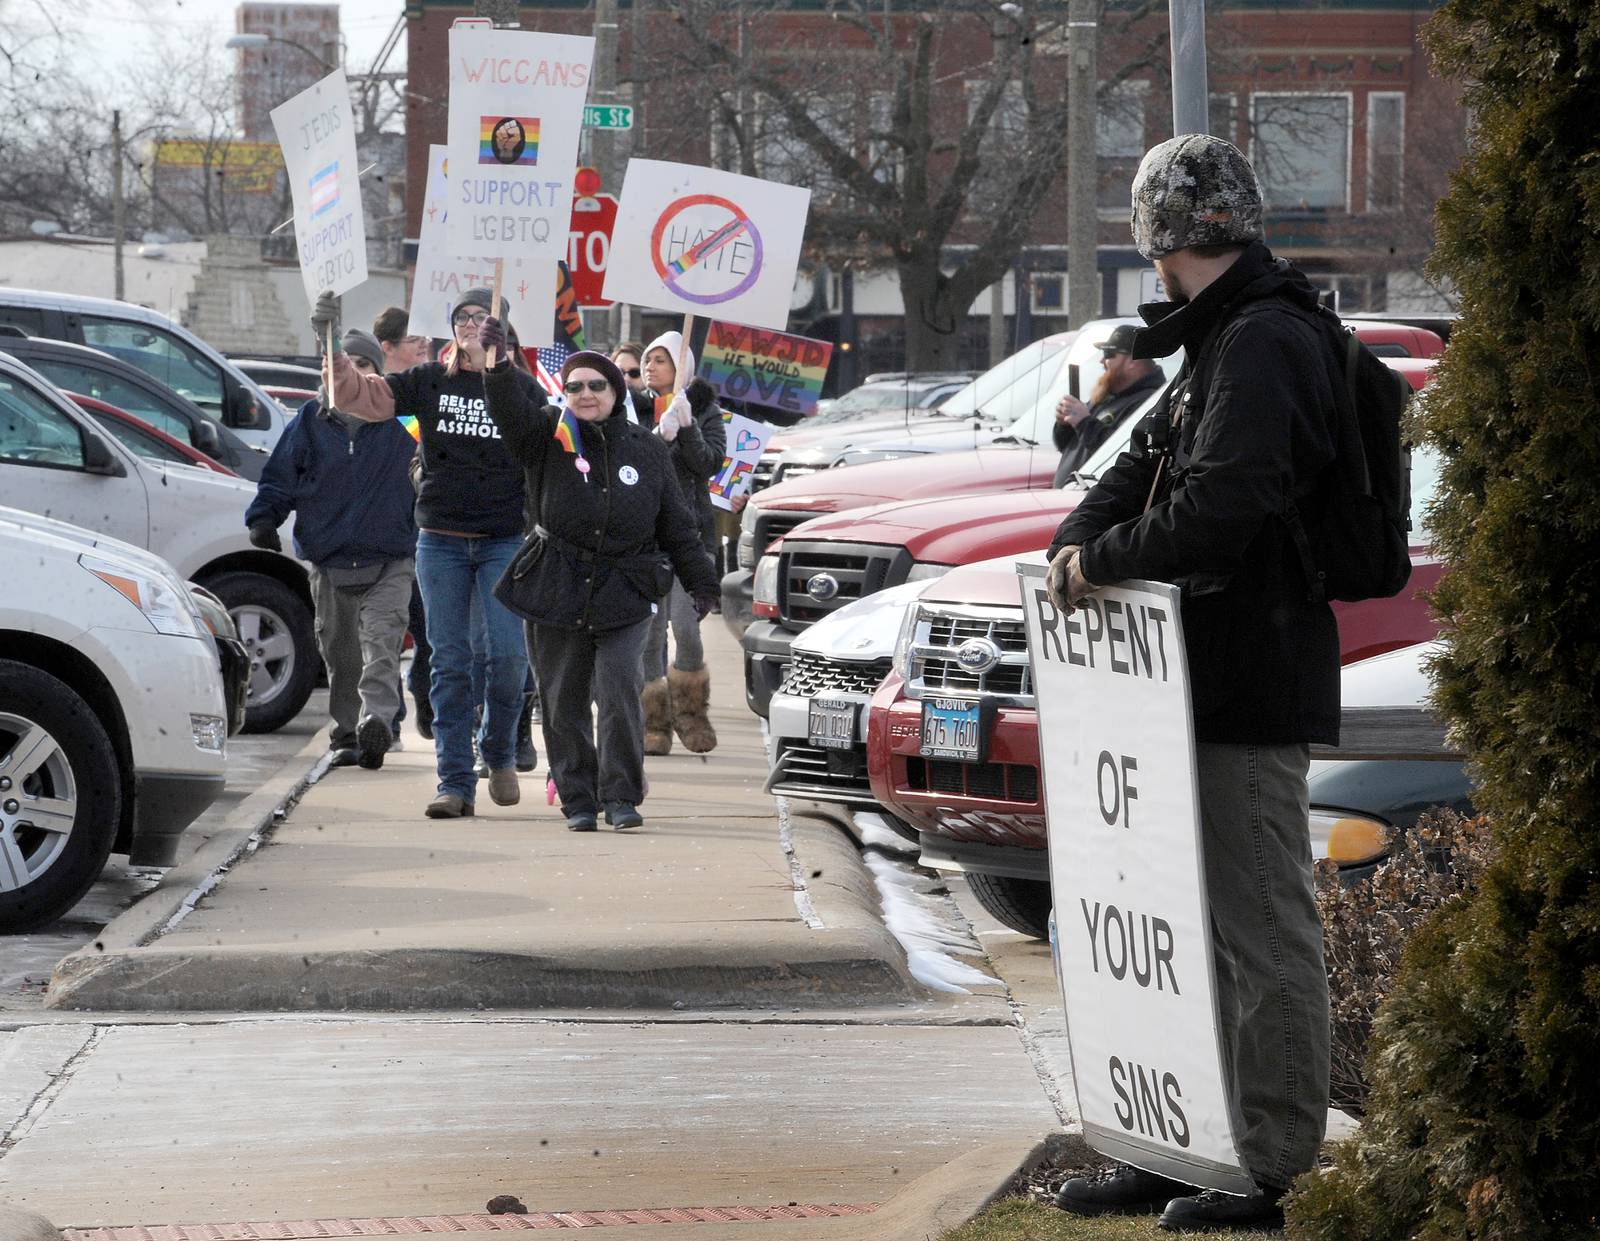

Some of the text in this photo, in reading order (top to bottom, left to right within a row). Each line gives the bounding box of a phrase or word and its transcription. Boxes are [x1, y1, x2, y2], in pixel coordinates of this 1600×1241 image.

[461, 57, 588, 89] WICCANS
[300, 105, 341, 151] JEDIS
[584, 108, 624, 126] lls St
[462, 179, 561, 207] SUPPORT
[302, 212, 354, 266] SUPPORT
[472, 215, 550, 243] LGBTQ
[567, 230, 610, 273] TO
[668, 224, 753, 275] HATE
[713, 320, 826, 368] WWJD
[722, 352, 800, 378] HE WOULD
[702, 361, 806, 407] LOVE
[439, 394, 485, 410] RELIG
[436, 419, 502, 439] ASSHOL
[468, 415, 480, 423] BE
[1035, 588, 1167, 682] REPENT
[818, 700, 846, 710] GERALD
[891, 725, 921, 738] ESCAP
[926, 715, 978, 747] 675 7600
[1098, 750, 1138, 829] OF
[1080, 898, 1180, 995] YOUR
[1109, 1055, 1191, 1149] SINS
